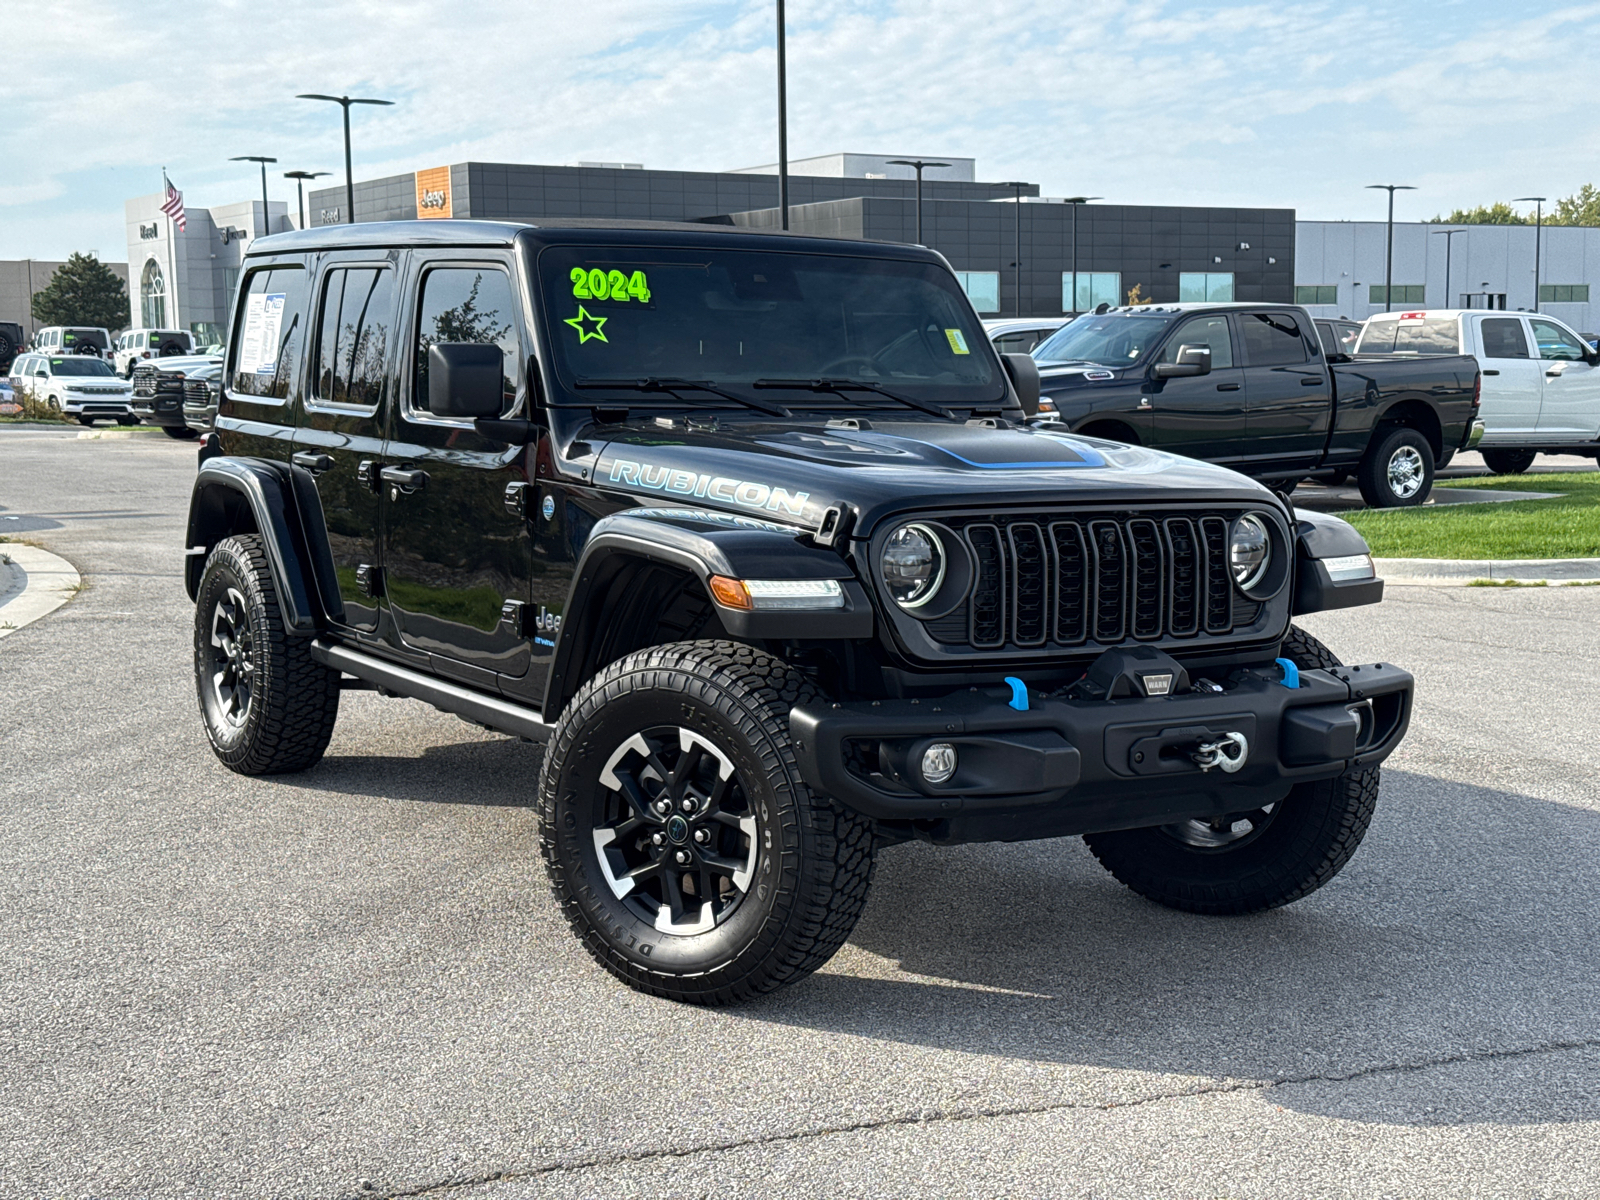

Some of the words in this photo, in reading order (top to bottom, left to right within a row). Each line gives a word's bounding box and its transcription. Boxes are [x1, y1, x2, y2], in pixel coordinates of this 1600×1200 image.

[421, 188, 447, 211] Jeep
[321, 207, 340, 225] Reed
[570, 267, 651, 303] 2024
[609, 459, 810, 516] RUBICON
[535, 605, 563, 633] Jee
[1148, 681, 1167, 689] WARN
